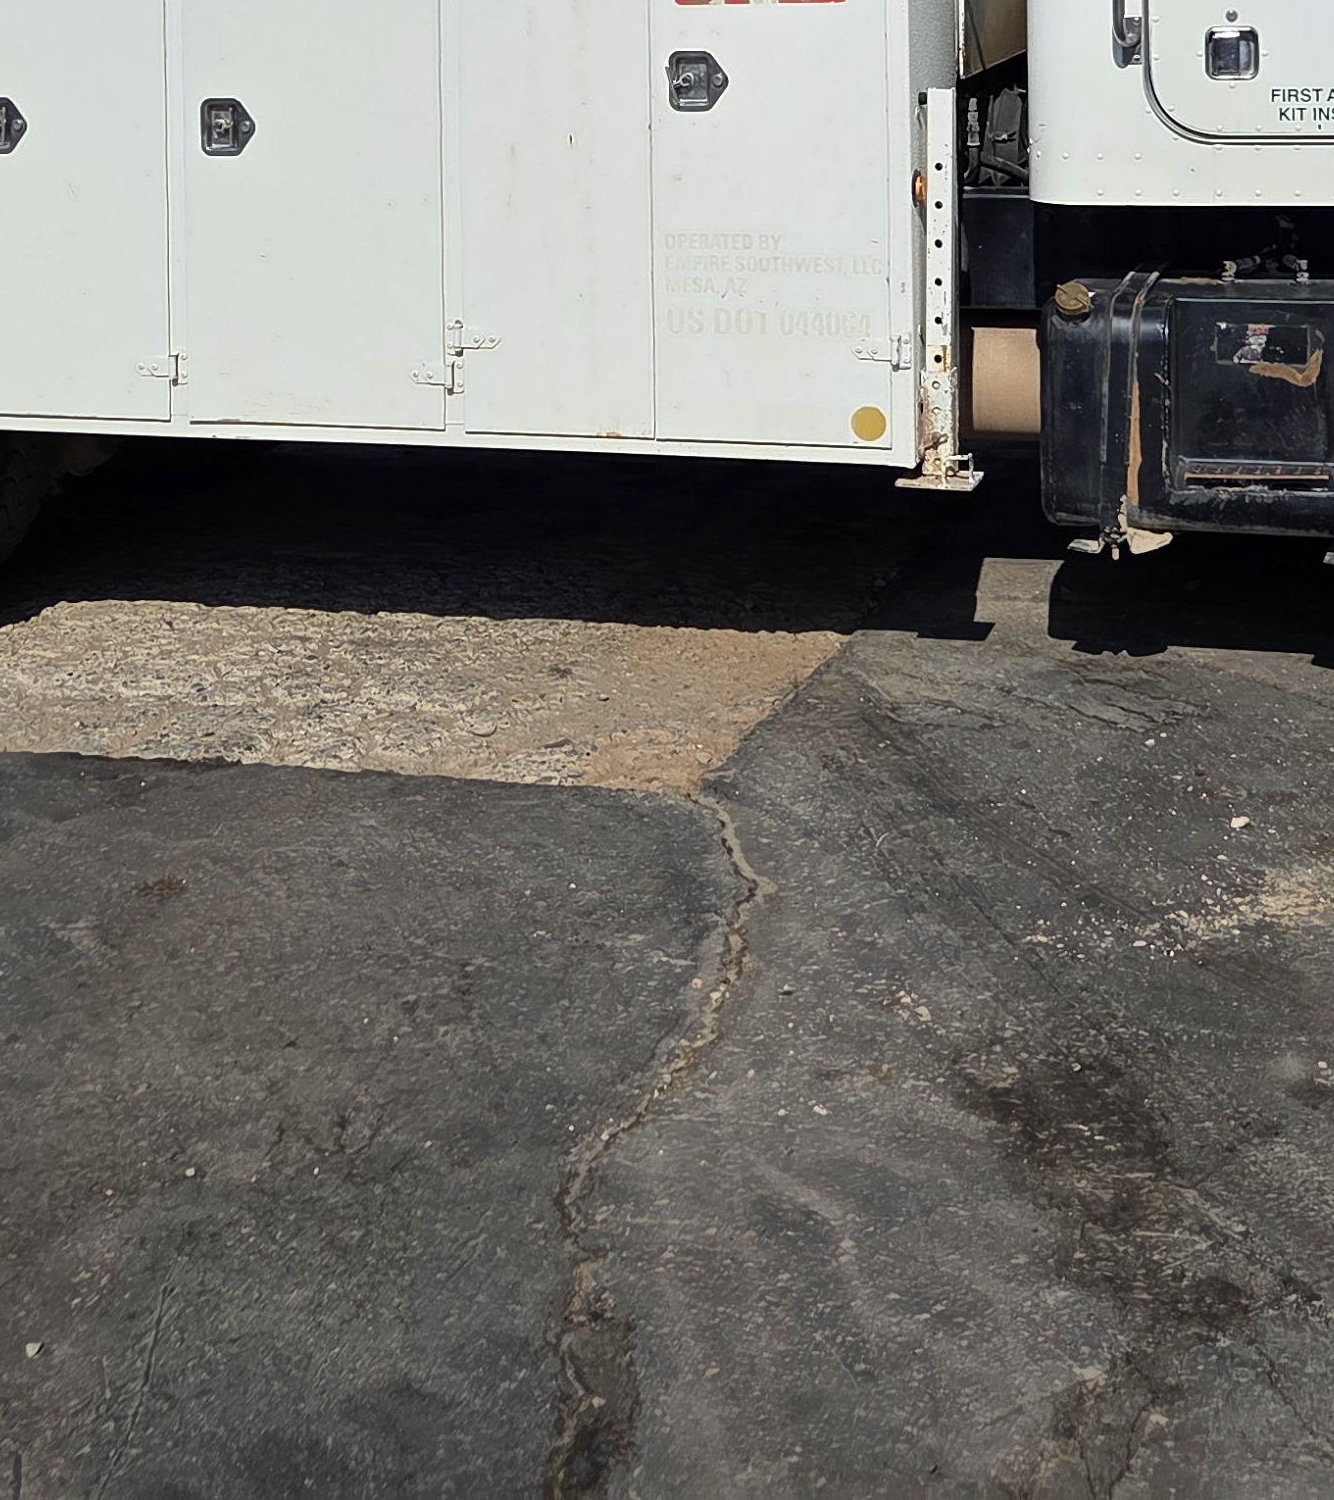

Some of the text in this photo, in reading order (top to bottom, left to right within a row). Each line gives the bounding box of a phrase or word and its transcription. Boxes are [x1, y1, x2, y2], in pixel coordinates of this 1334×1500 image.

[1271, 88, 1324, 102] FIRST
[1278, 107, 1308, 121] KIT
[664, 233, 782, 250] OPERATED BY
[852, 257, 883, 276] LLC
[723, 277, 748, 295] AZ
[667, 308, 704, 334] US
[713, 308, 767, 335] DOT
